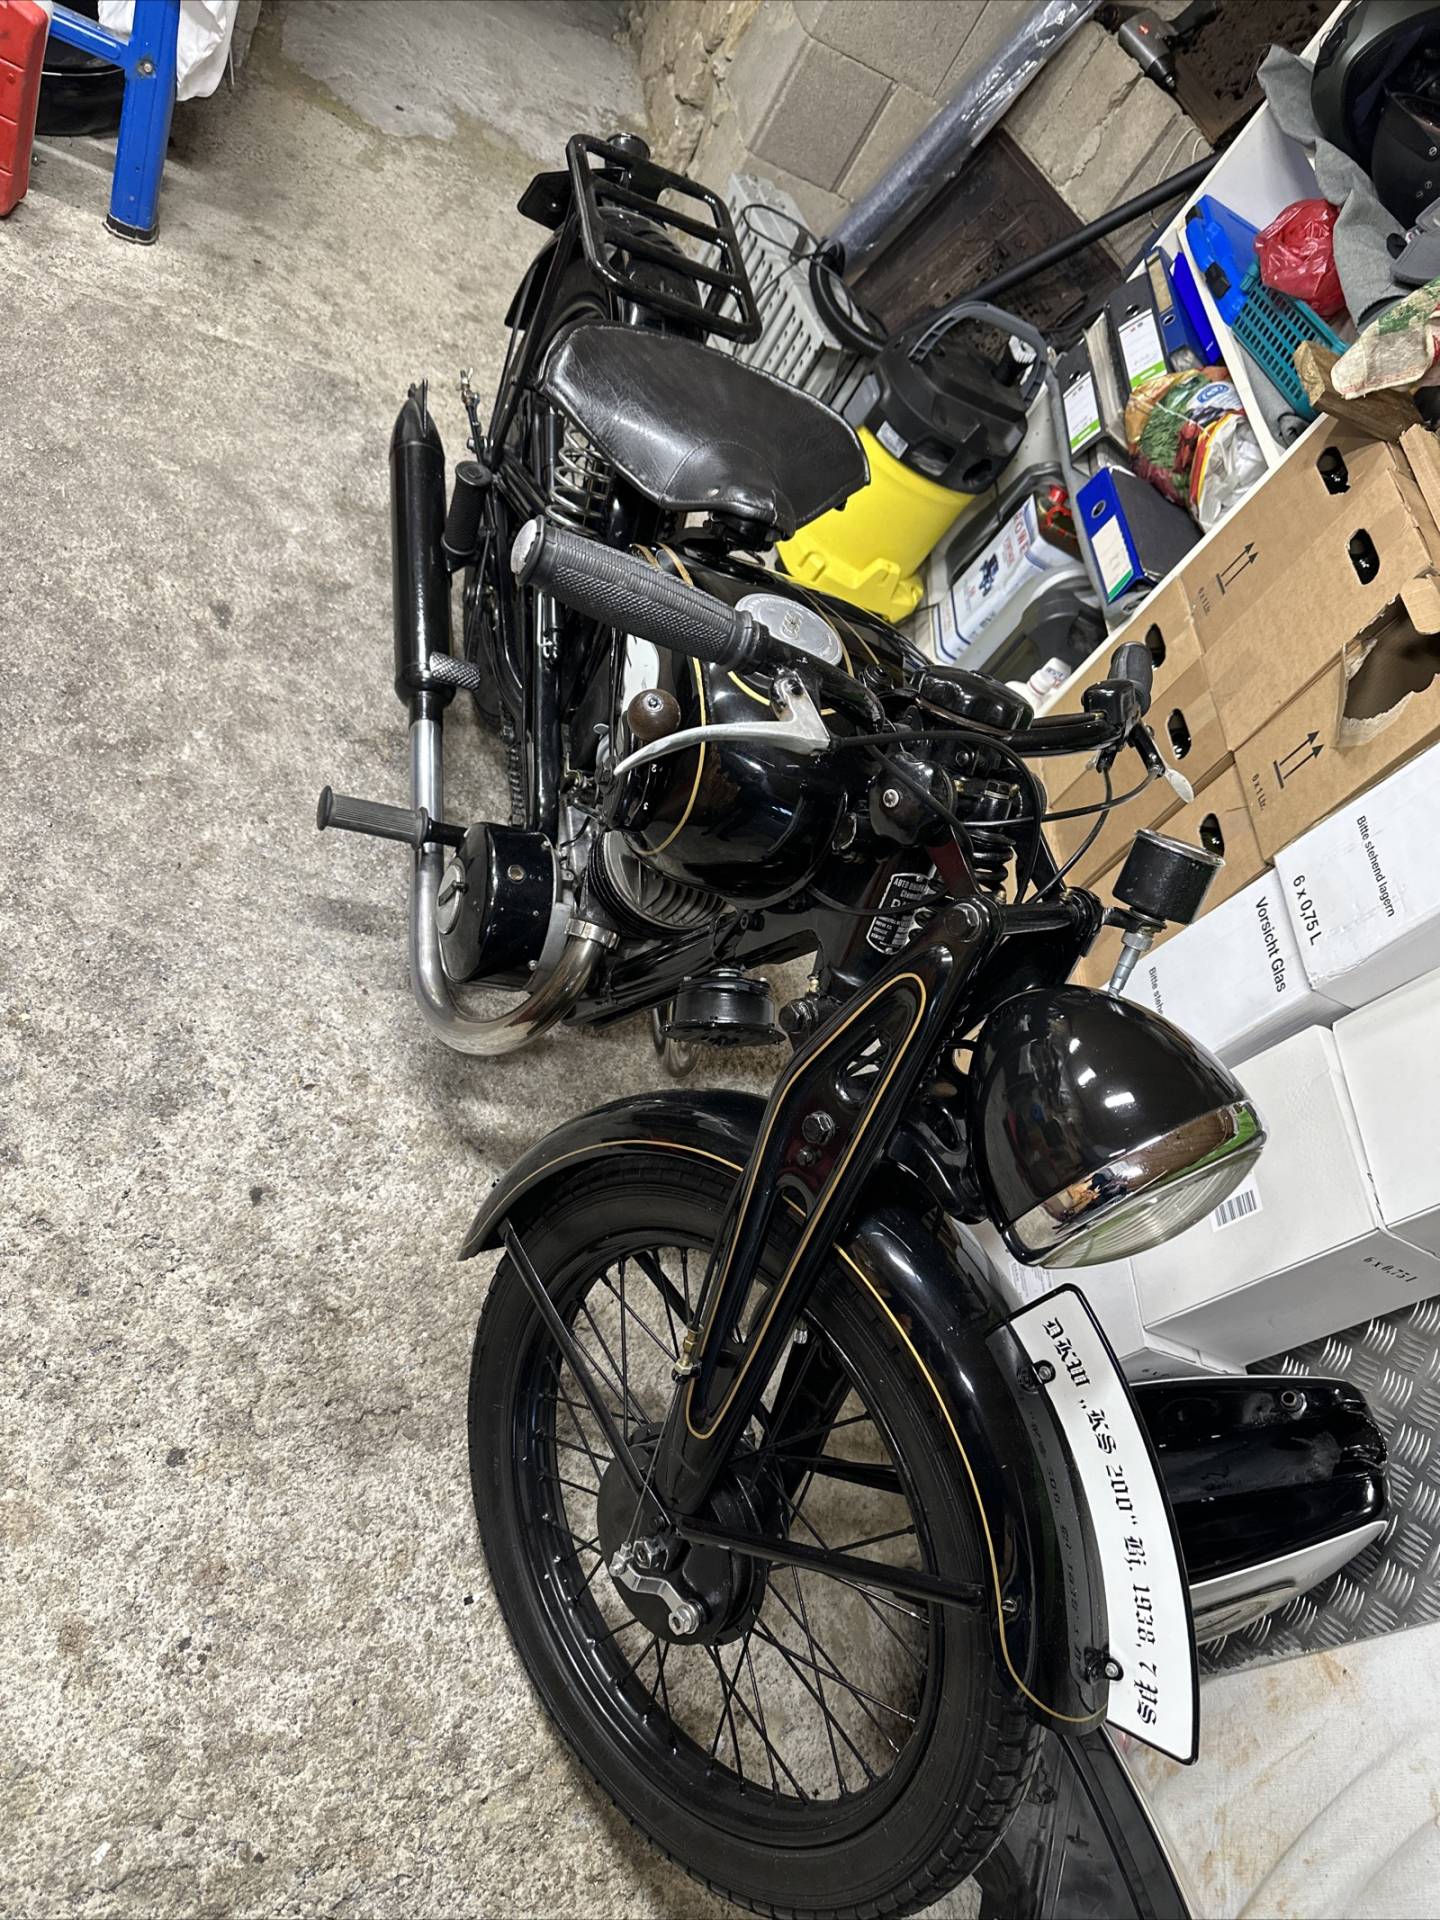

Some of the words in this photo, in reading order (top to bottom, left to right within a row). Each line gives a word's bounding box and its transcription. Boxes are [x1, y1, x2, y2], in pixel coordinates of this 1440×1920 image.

[1356, 815, 1370, 841] Bitte
[1364, 841, 1386, 883] stehend
[1378, 881, 1395, 918] lagern
[1293, 875, 1306, 887] 6
[1296, 890, 1307, 899] x
[1300, 900, 1320, 931] 0,75
[1255, 896, 1280, 958] Vorsicht
[1271, 957, 1287, 993] Glas
[1310, 931, 1322, 946] L
[1149, 966, 1159, 990] Bitte
[1042, 1317, 1091, 1387] DKW
[1138, 1661, 1158, 1678] 7
[1134, 1680, 1159, 1726] PS
